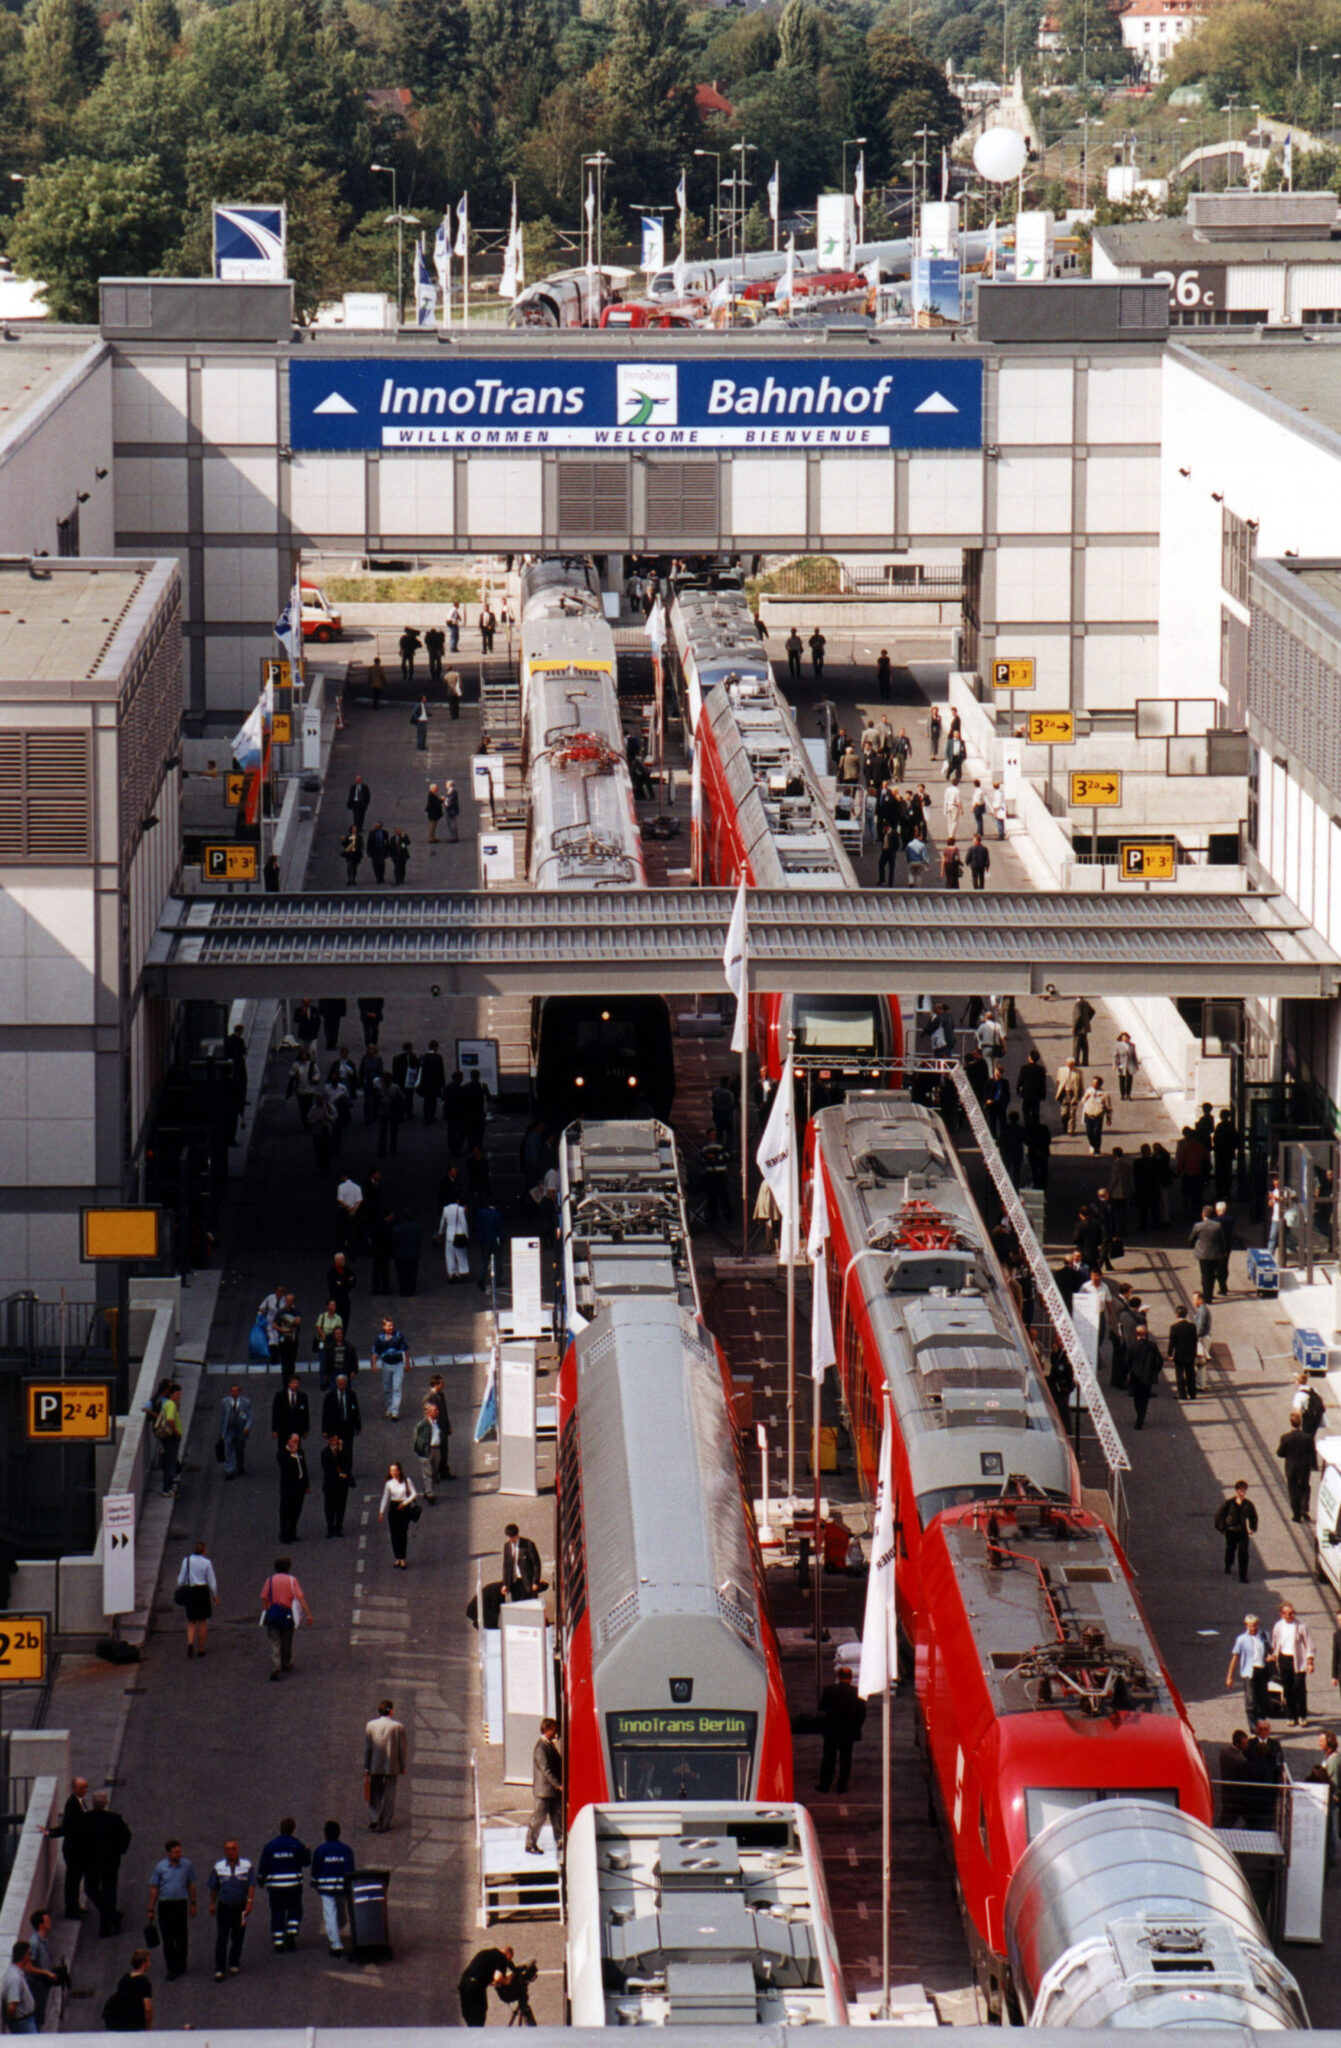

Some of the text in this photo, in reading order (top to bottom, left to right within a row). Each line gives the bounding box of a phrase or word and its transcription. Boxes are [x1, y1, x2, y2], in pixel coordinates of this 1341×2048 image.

[623, 369, 671, 382] InnoTrans
[379, 378, 585, 415] InnoTrans
[707, 375, 894, 415] Bahnhof
[399, 430, 871, 443] WILLKOMMEN WELCOME BIENVENUE
[997, 665, 1008, 680] P
[212, 851, 224, 868] P
[1129, 850, 1142, 868] P
[40, 1395, 58, 1421] P
[618, 1717, 745, 1733] InnoTrans Berlin
